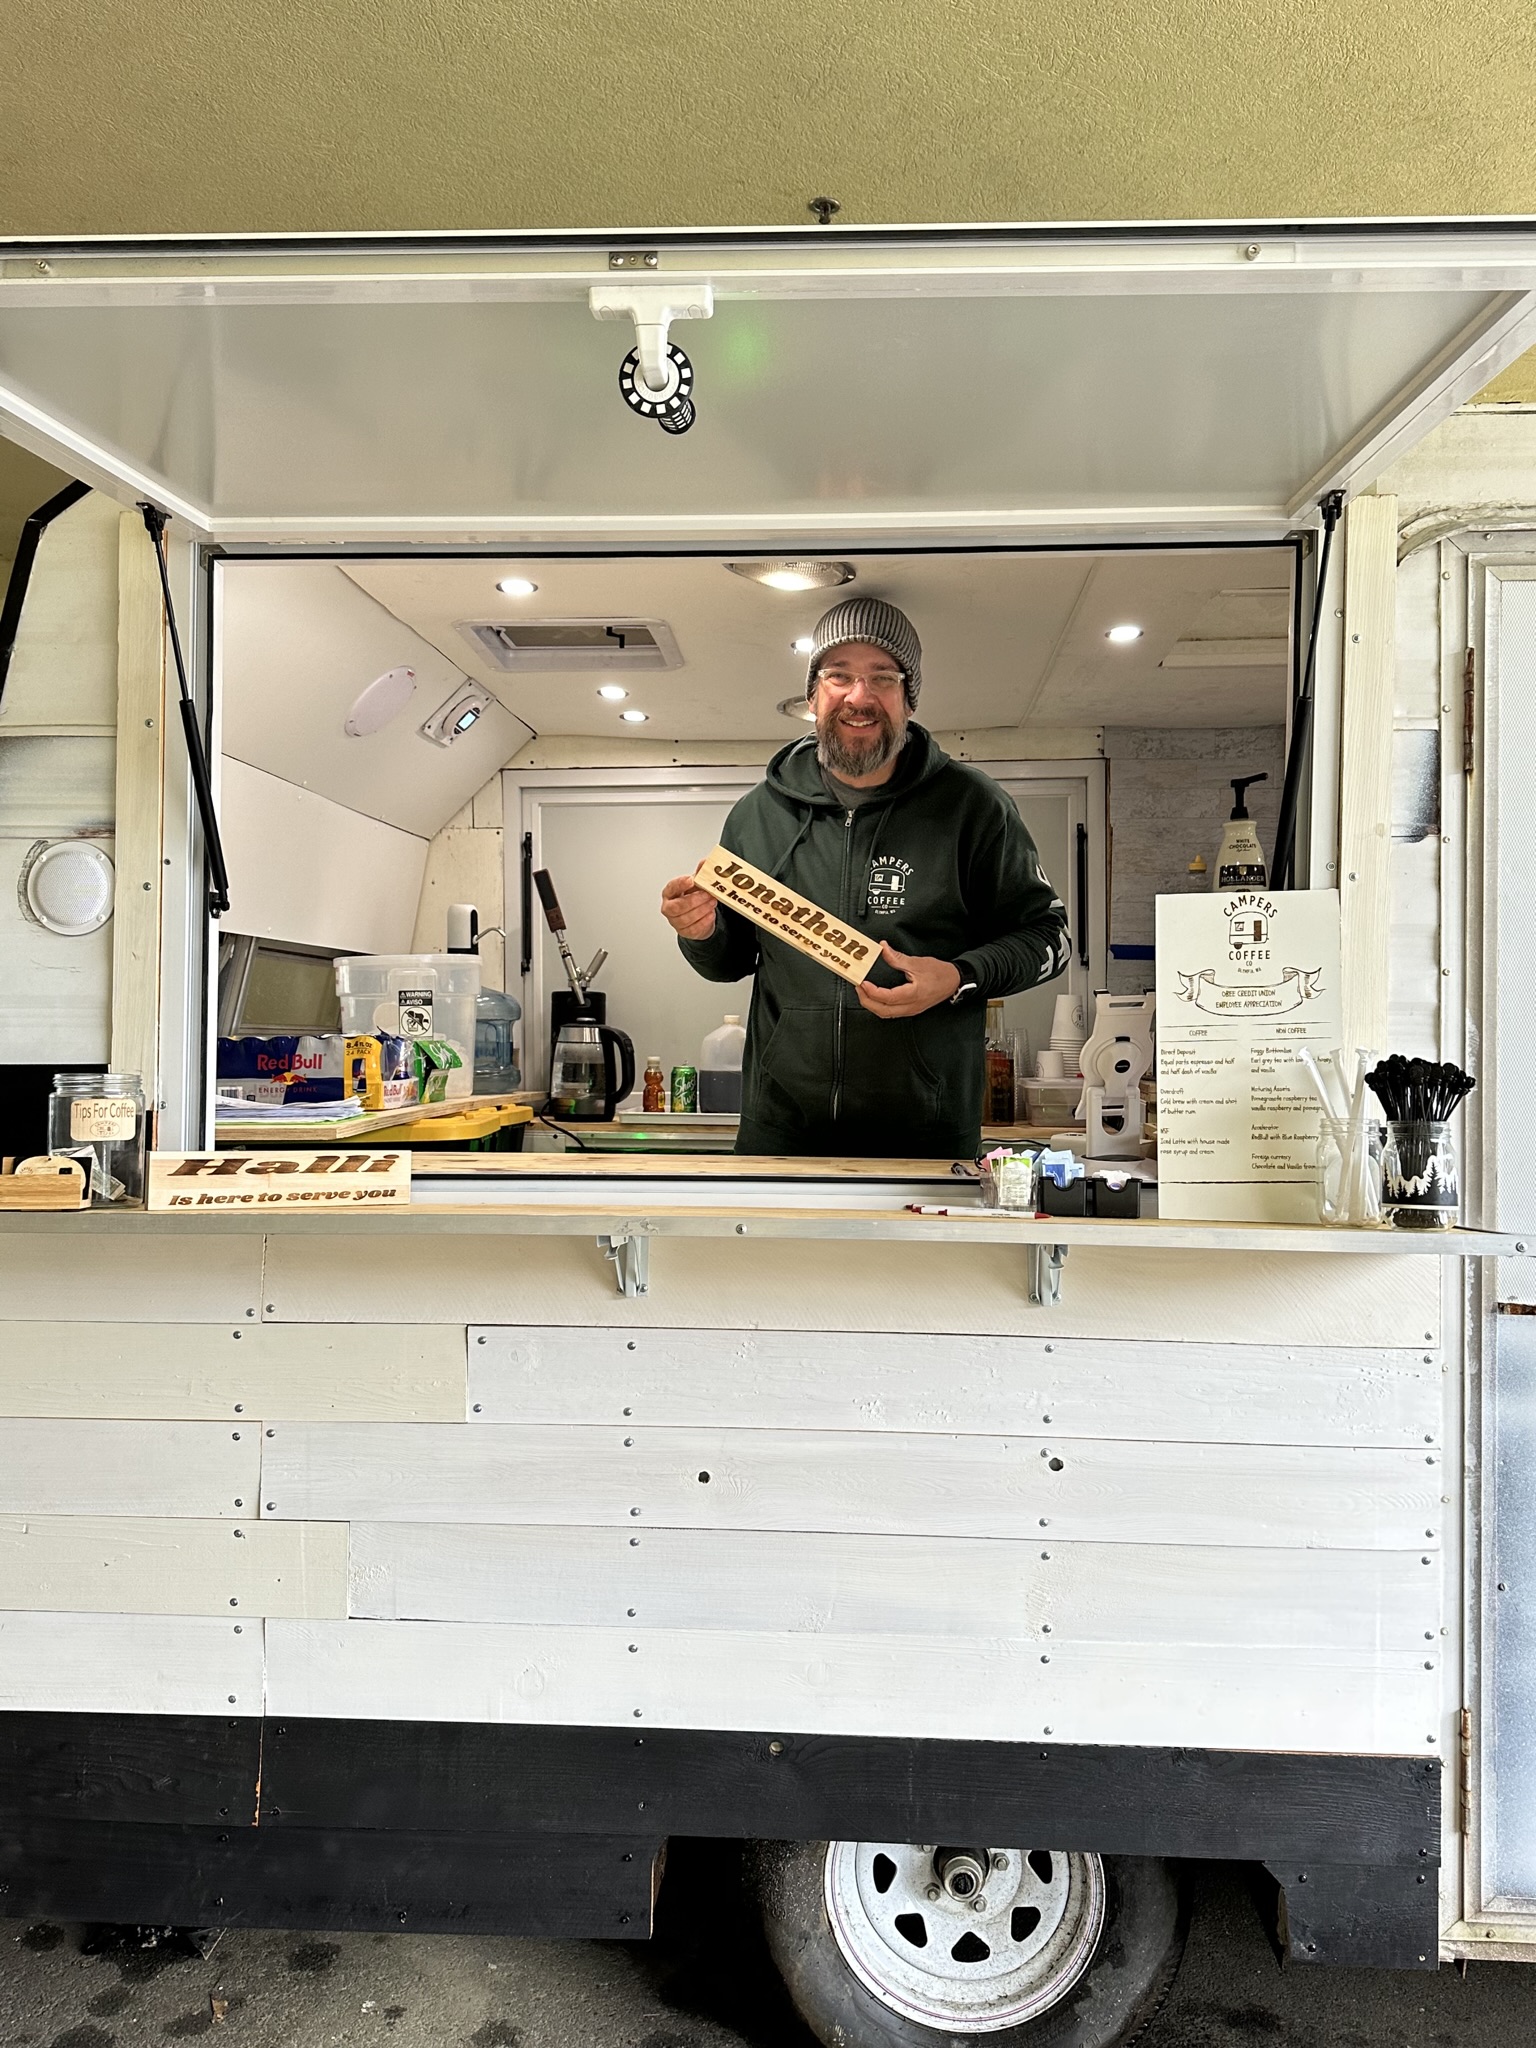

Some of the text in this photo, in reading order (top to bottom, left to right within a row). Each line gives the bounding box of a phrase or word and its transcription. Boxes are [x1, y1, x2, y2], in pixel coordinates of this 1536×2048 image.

[870, 856, 914, 876] AMPERS
[867, 896, 905, 905] COFFEE
[1223, 895, 1278, 918] CAMPERS
[714, 861, 869, 961] Jonathan
[710, 880, 851, 970] Is here to serve you
[1228, 950, 1270, 960] COFFEE
[1251, 1047, 1264, 1056] Foggy
[257, 1054, 322, 1070] Red Bull
[1283, 1095, 1307, 1103] raspberry
[73, 1103, 134, 1121] Tips For Coffee
[1294, 1133, 1319, 1142] Raspberry
[167, 1155, 400, 1176] Halli
[1252, 1153, 1269, 1162] Foreign
[168, 1189, 397, 1206] Is here to serve you
